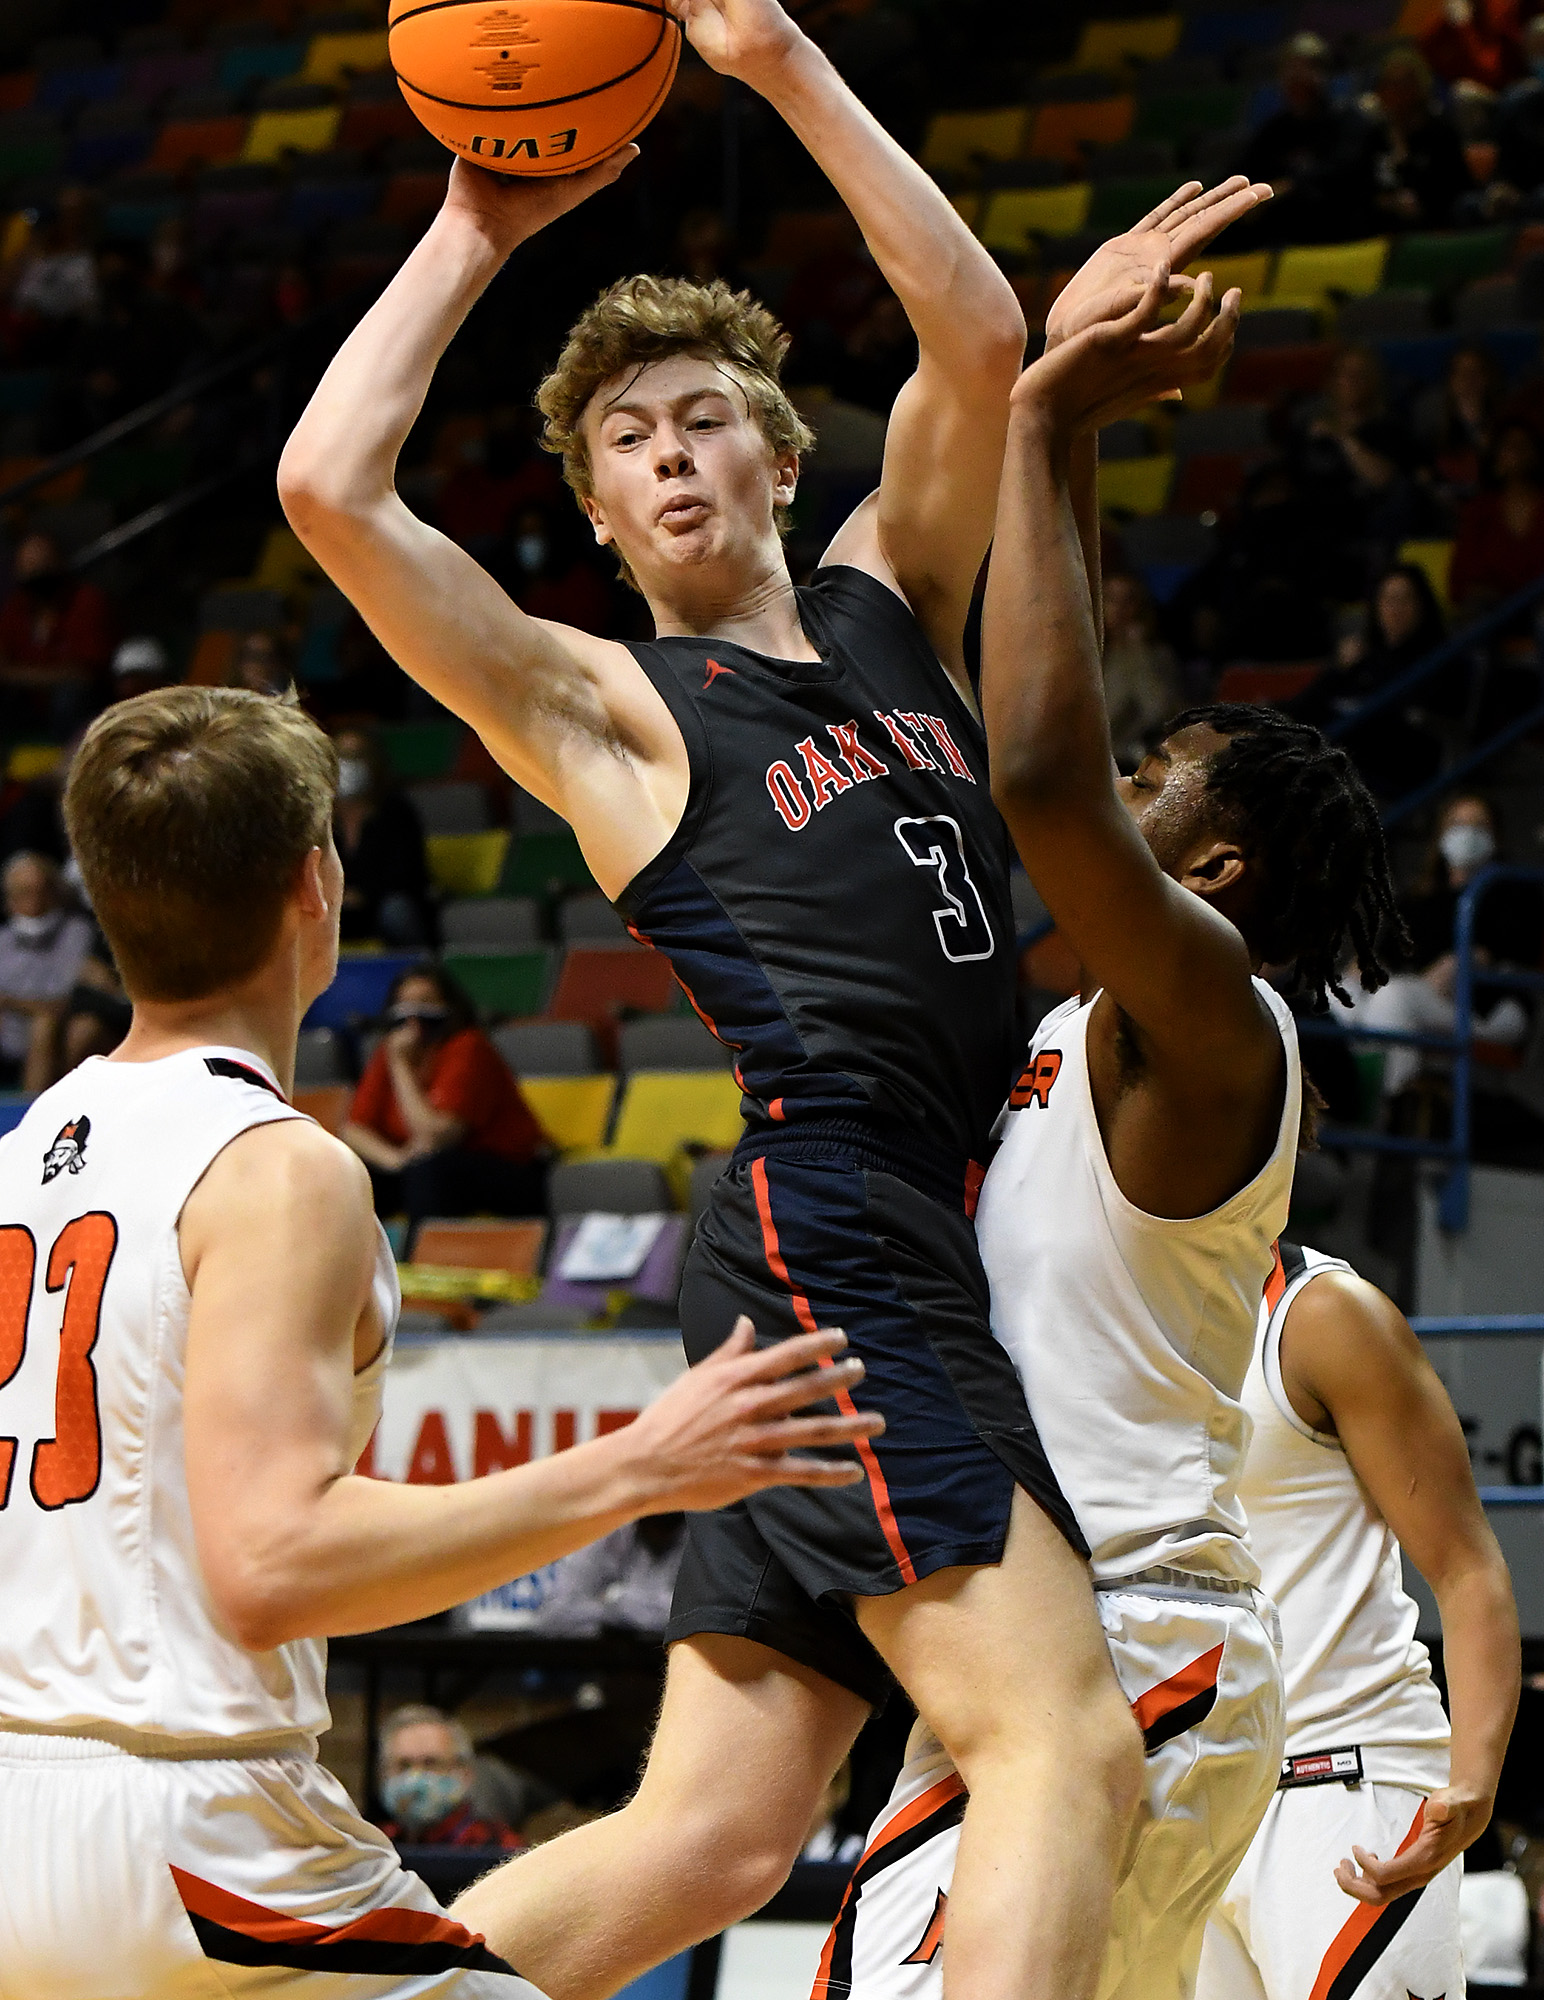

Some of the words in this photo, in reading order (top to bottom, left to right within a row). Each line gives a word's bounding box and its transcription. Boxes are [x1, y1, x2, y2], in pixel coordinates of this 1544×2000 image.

[470, 128, 578, 159] EVO
[765, 719, 890, 832] OAK
[894, 814, 995, 963] 3
[1296, 1761, 1331, 1775] AUTHENTIC
